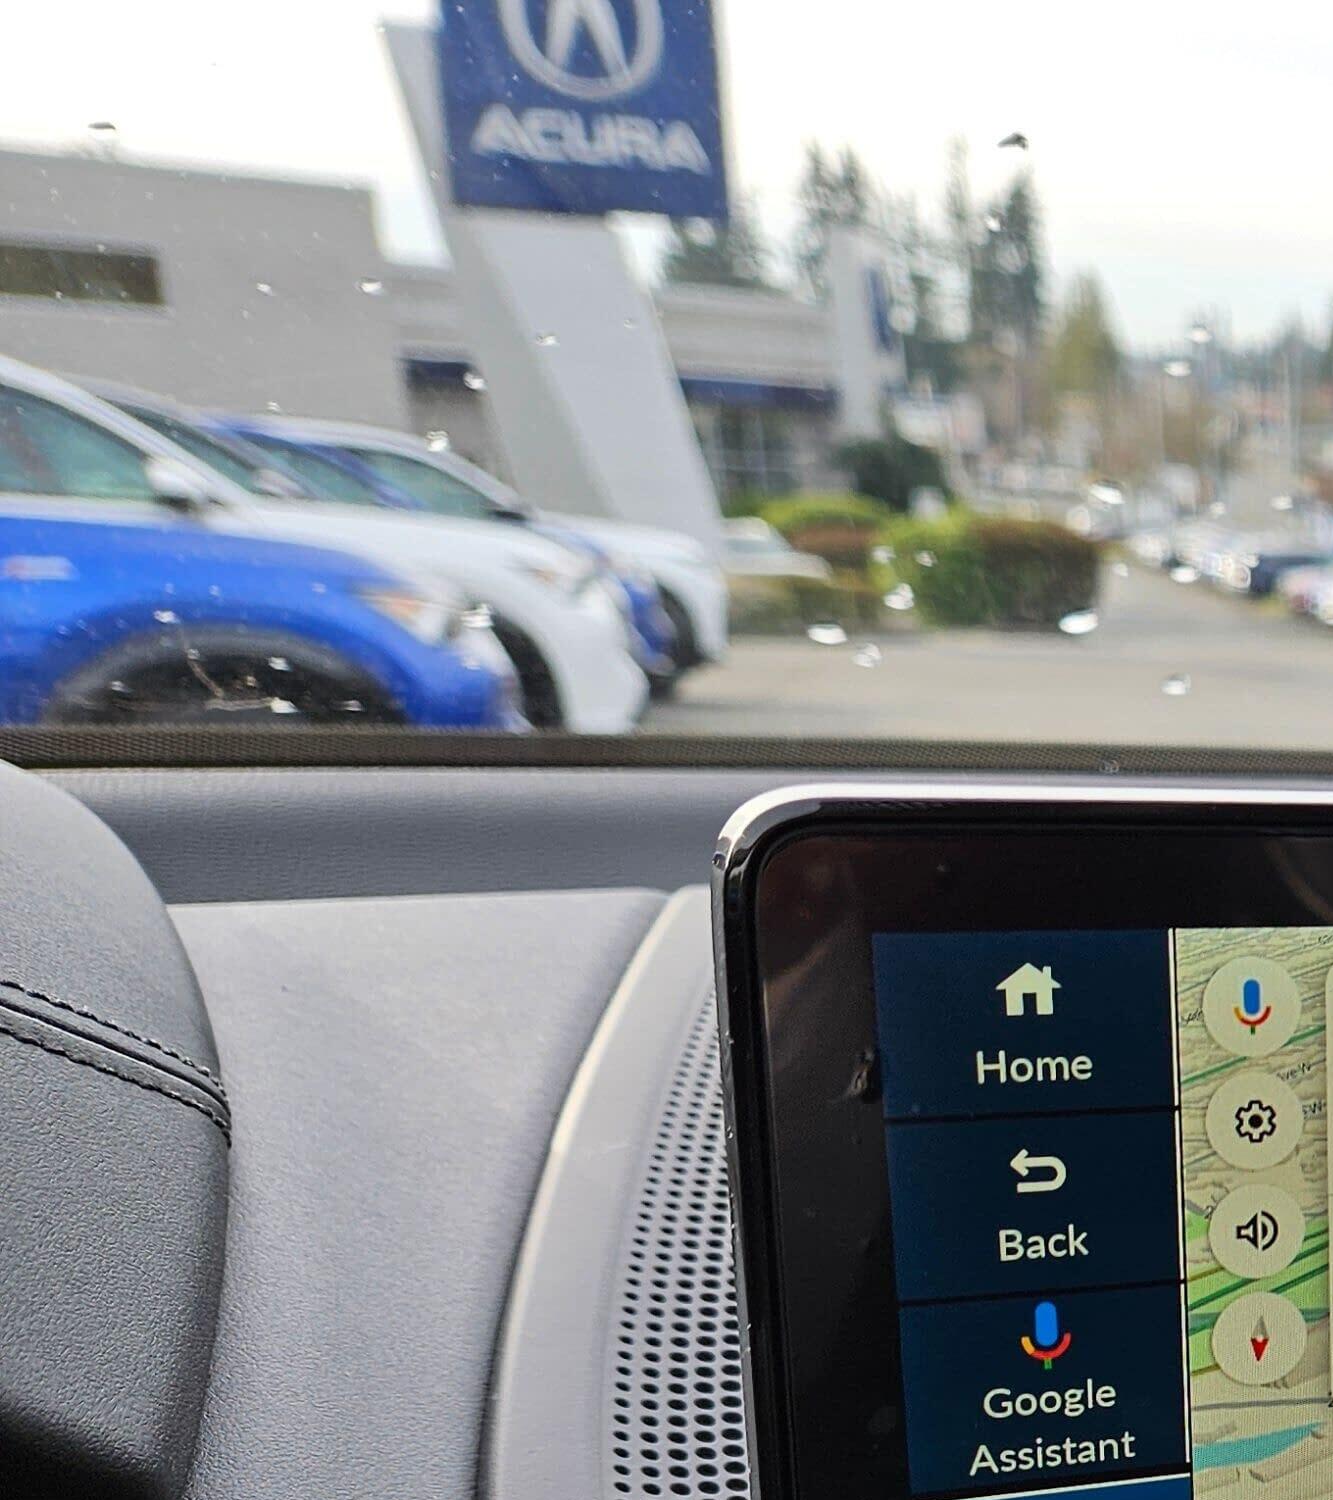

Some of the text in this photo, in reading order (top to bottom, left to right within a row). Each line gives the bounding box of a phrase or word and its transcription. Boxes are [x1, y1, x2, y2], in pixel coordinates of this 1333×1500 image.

[470, 103, 711, 176] ACURA
[975, 1051, 1093, 1084] Home
[998, 1224, 1089, 1262] Back
[982, 1378, 1117, 1418] Google
[968, 1429, 1137, 1477] Assistant
